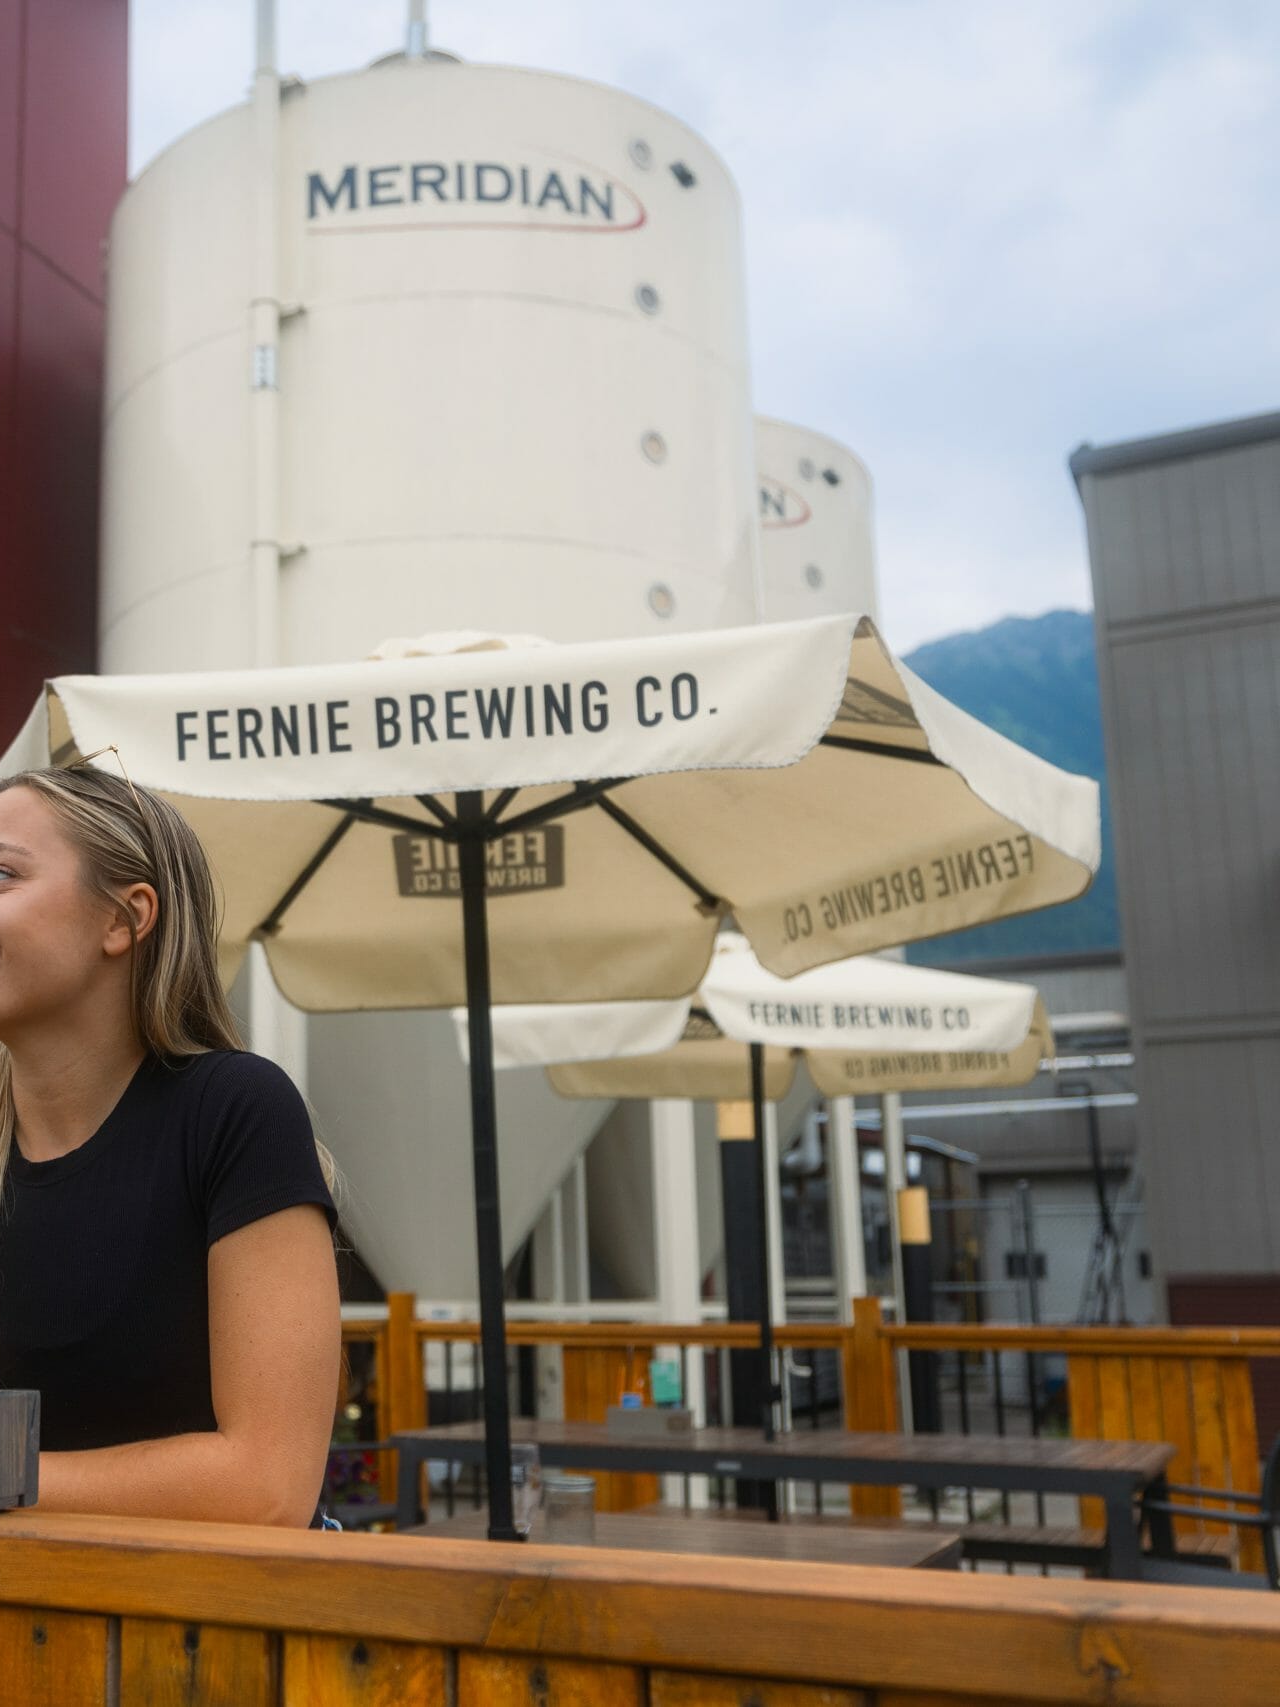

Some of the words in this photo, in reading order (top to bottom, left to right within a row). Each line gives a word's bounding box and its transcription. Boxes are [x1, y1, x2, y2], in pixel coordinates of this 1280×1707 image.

[306, 161, 615, 221] MERIDIAN
[176, 699, 353, 762] FERNIE
[375, 680, 610, 749] BREWING
[635, 671, 719, 728] CO.
[749, 1002, 825, 1029] FERNIE
[833, 1005, 933, 1031] BREWING
